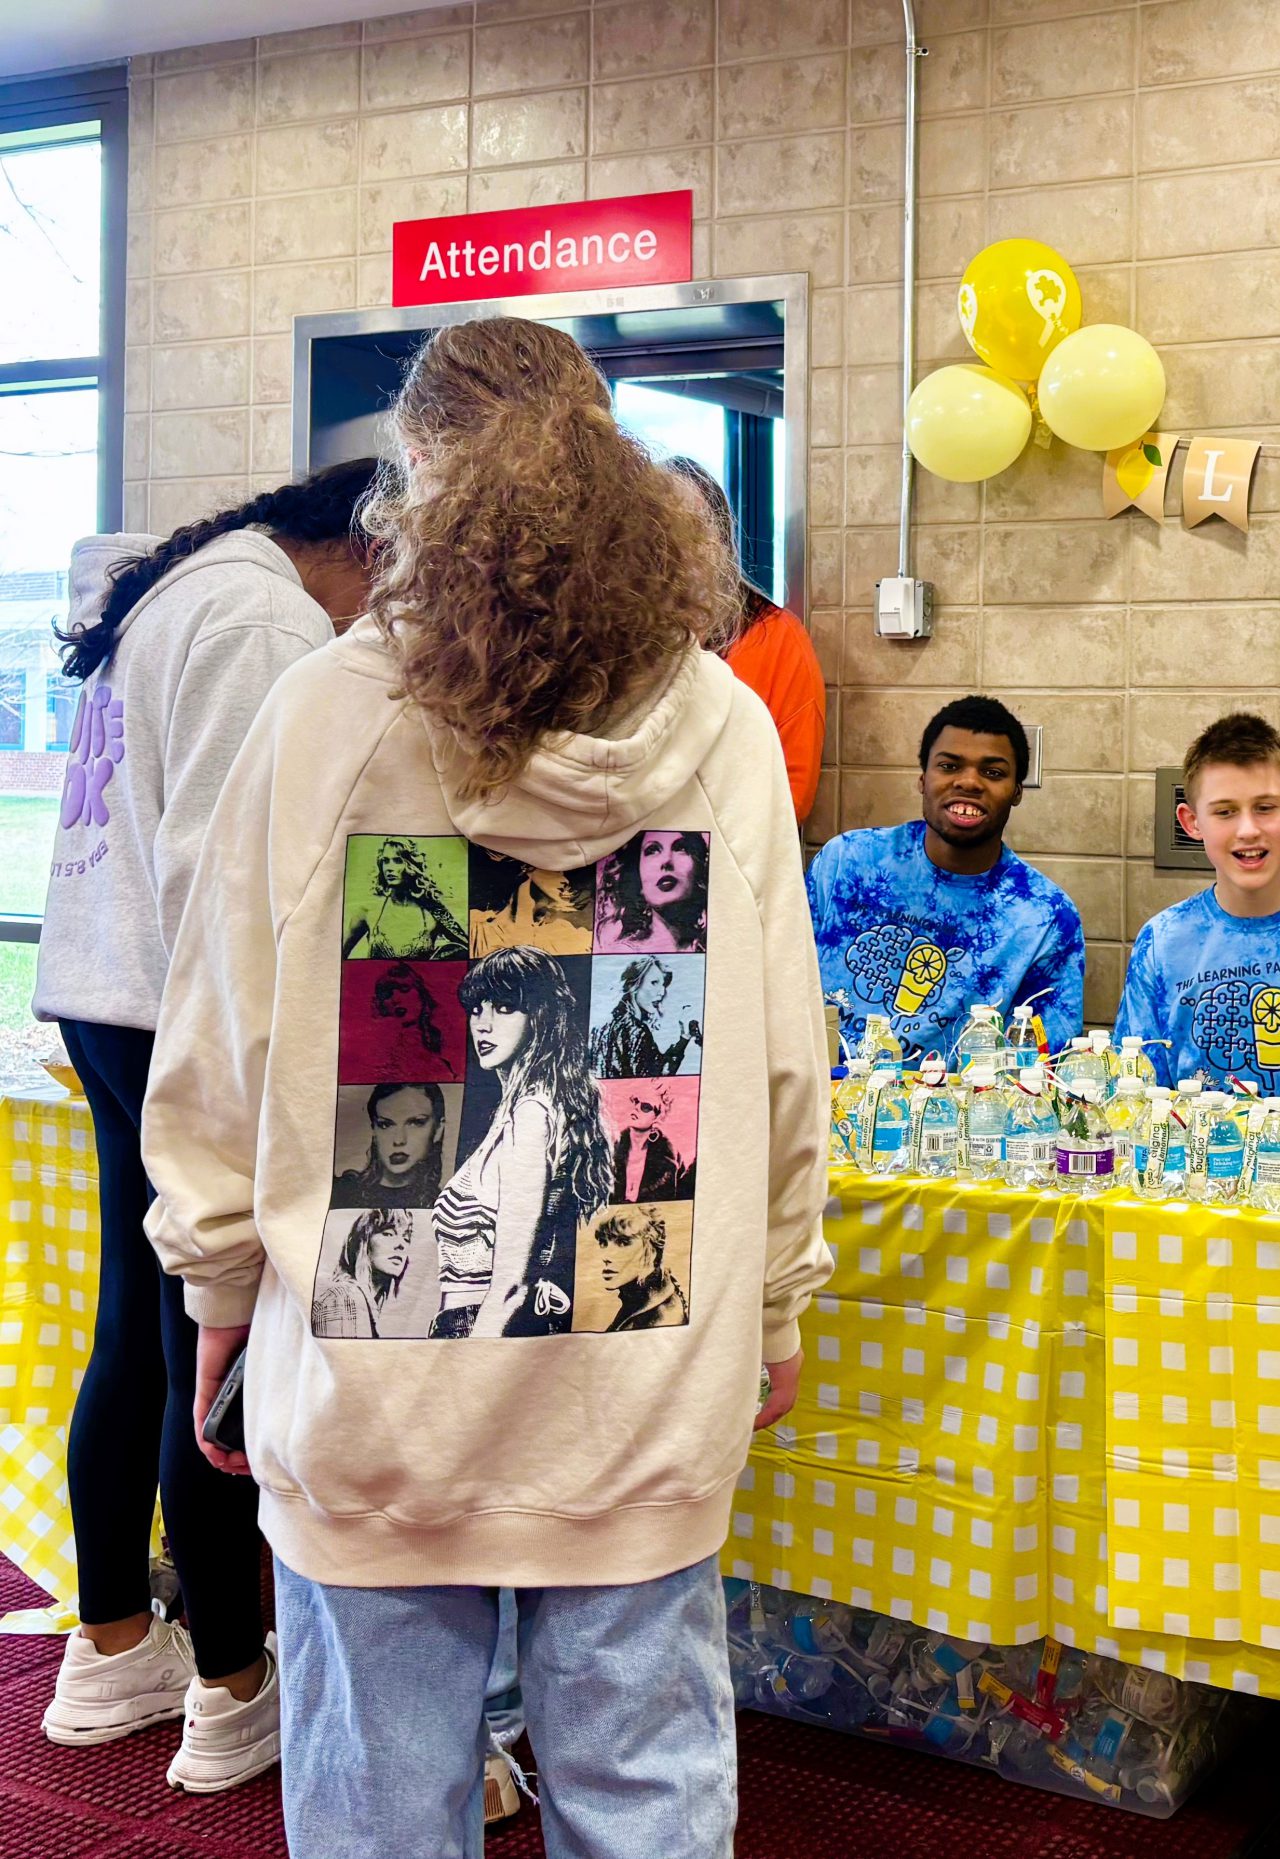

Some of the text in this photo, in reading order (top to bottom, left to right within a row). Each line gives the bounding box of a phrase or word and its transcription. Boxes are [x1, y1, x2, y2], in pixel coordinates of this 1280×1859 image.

[419, 227, 658, 282] Attendance
[1197, 963, 1261, 983] LEARNING
[1152, 1123, 1160, 1158] original
[1196, 1137, 1206, 1173] original
